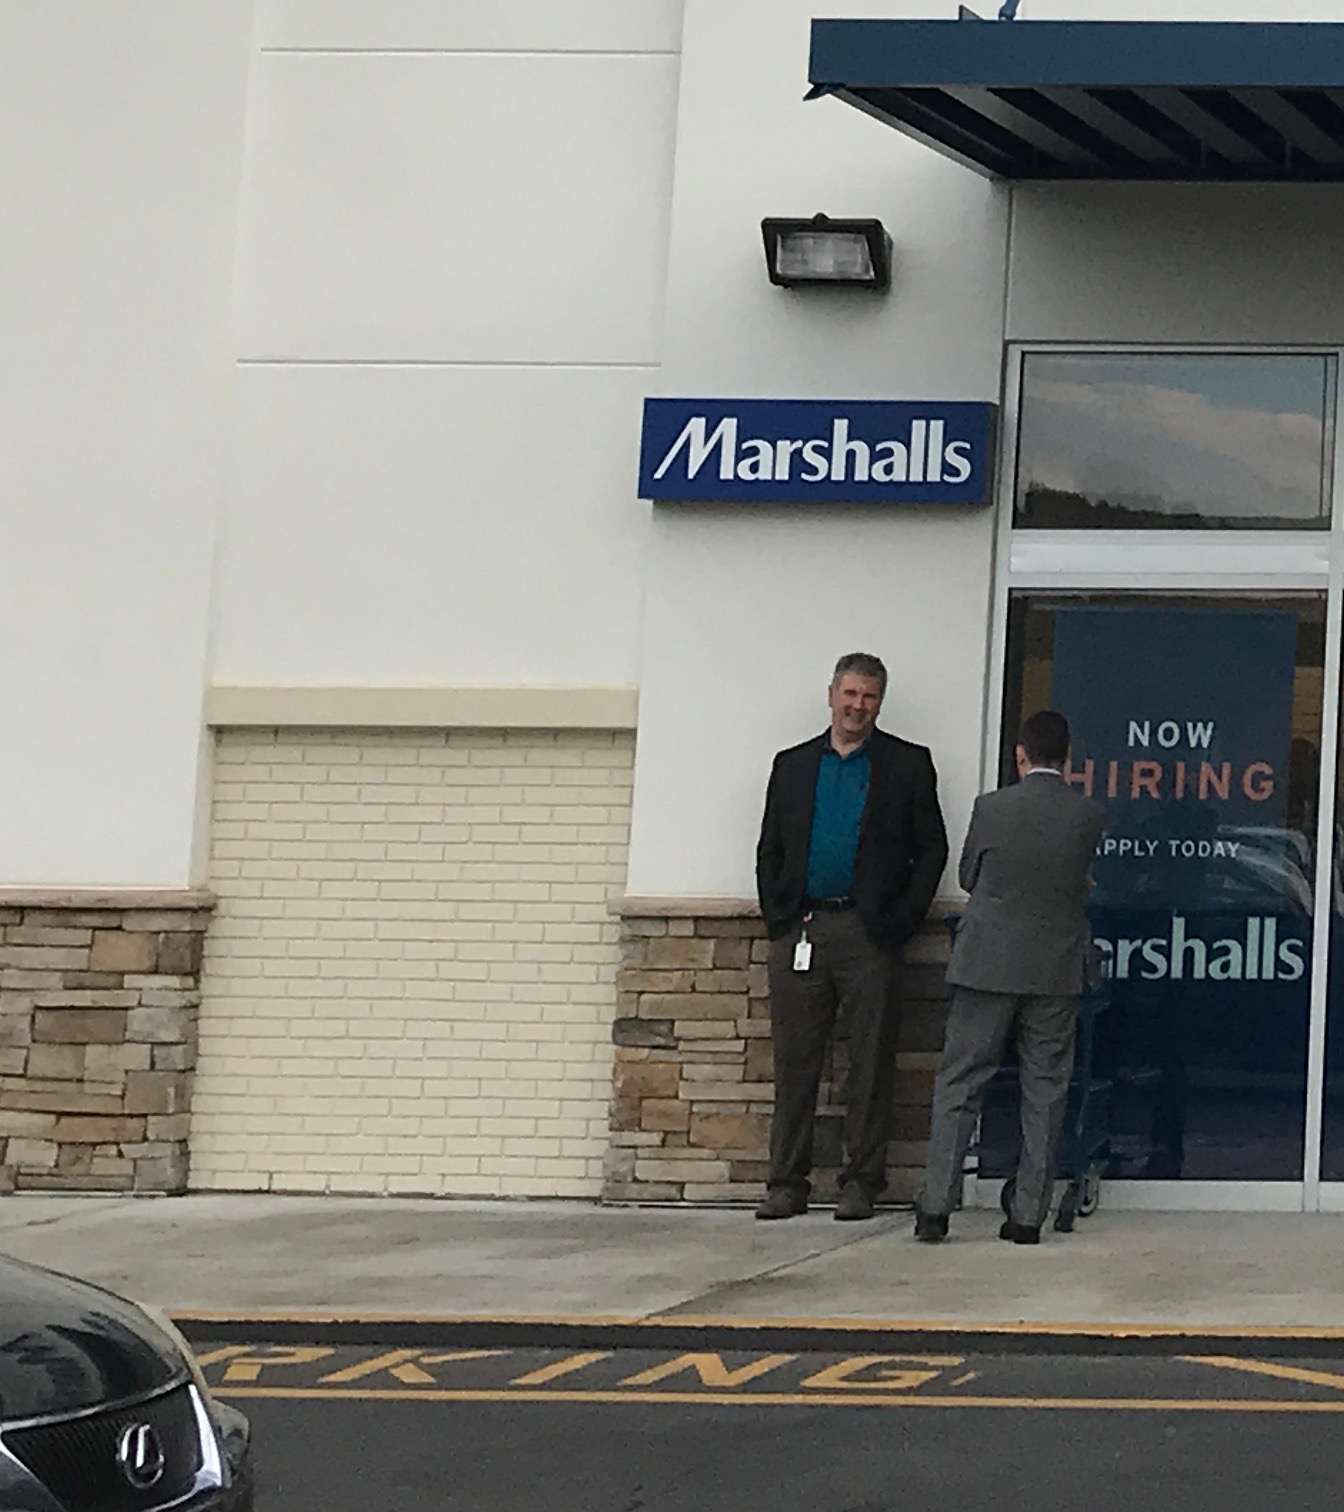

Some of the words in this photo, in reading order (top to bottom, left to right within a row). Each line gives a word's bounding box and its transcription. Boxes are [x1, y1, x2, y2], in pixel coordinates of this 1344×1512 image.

[653, 416, 972, 483] Marshalls
[1127, 719, 1215, 750] NOW
[1064, 758, 1275, 802] HIRING
[1168, 839, 1240, 858] TODAY
